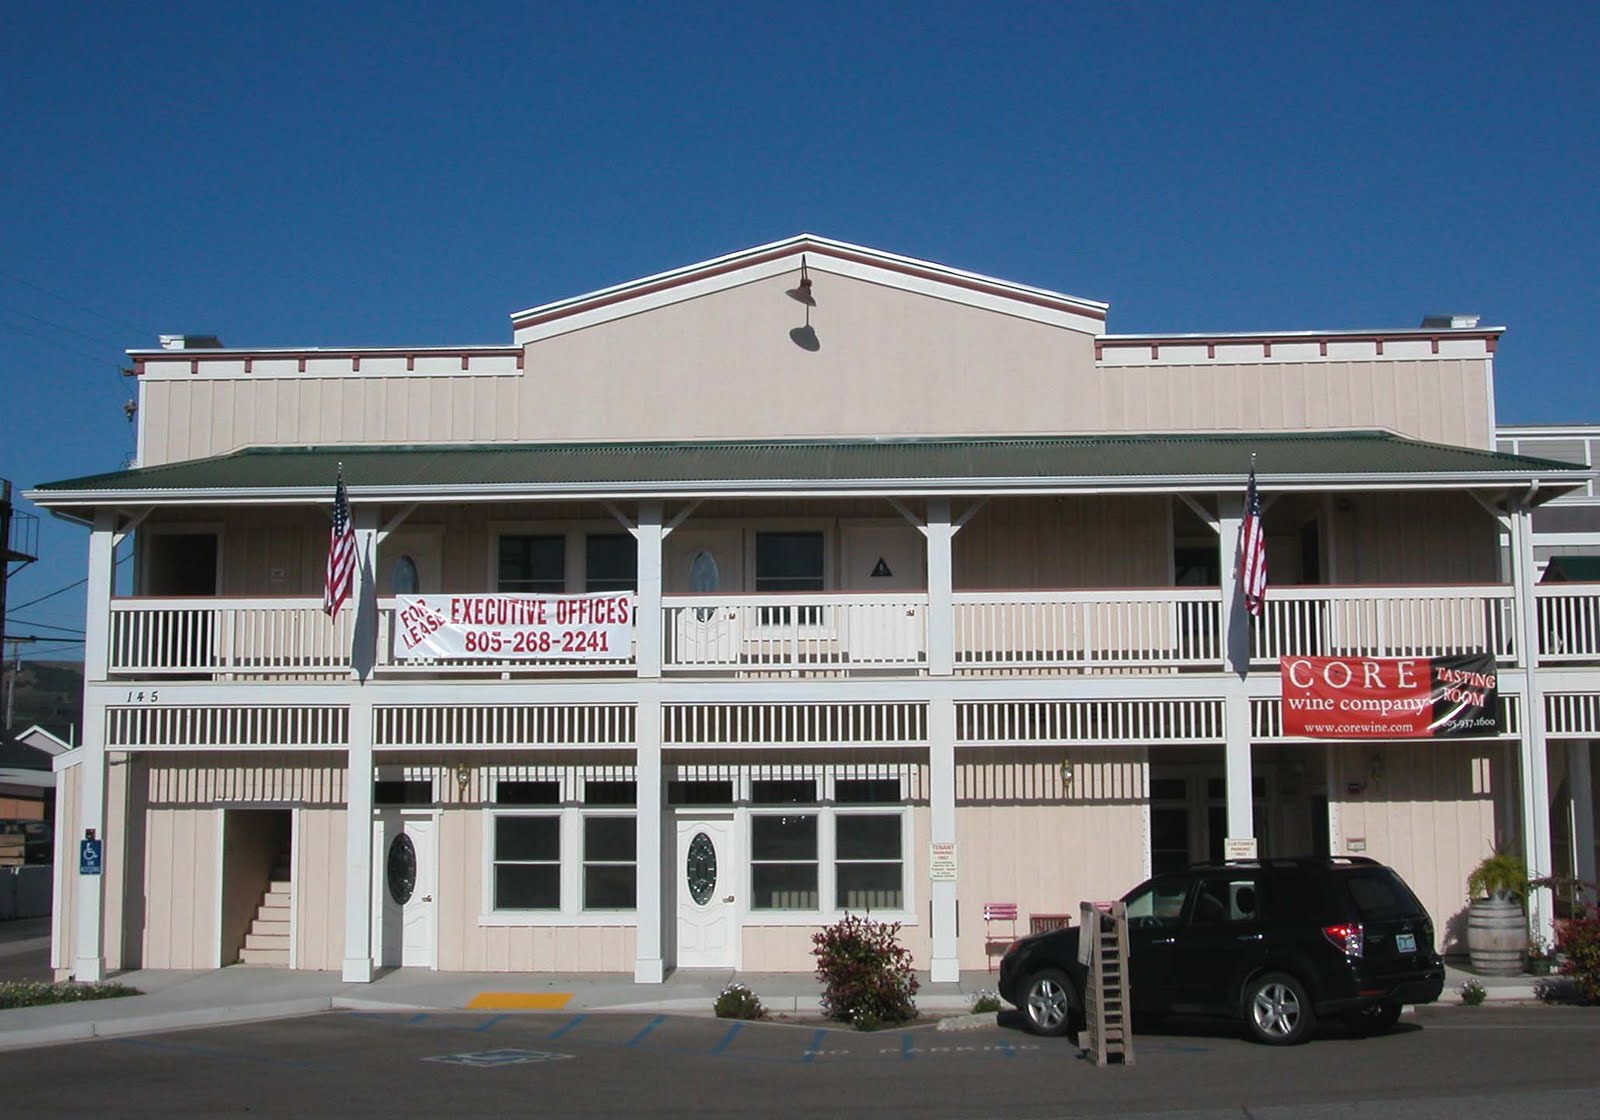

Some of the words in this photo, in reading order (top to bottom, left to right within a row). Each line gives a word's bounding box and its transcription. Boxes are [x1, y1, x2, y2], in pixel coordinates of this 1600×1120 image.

[451, 597, 547, 625] EXECUTIVE
[556, 597, 629, 625] OFFICES
[465, 630, 609, 653] 805-268-2241
[1289, 659, 1418, 689] CORE
[1435, 666, 1496, 689] TASTING
[126, 690, 159, 703] 145
[1288, 692, 1335, 711] wine
[1340, 699, 1426, 716] company
[1443, 686, 1486, 708] ROOM
[1304, 721, 1414, 734] www.corewine.com
